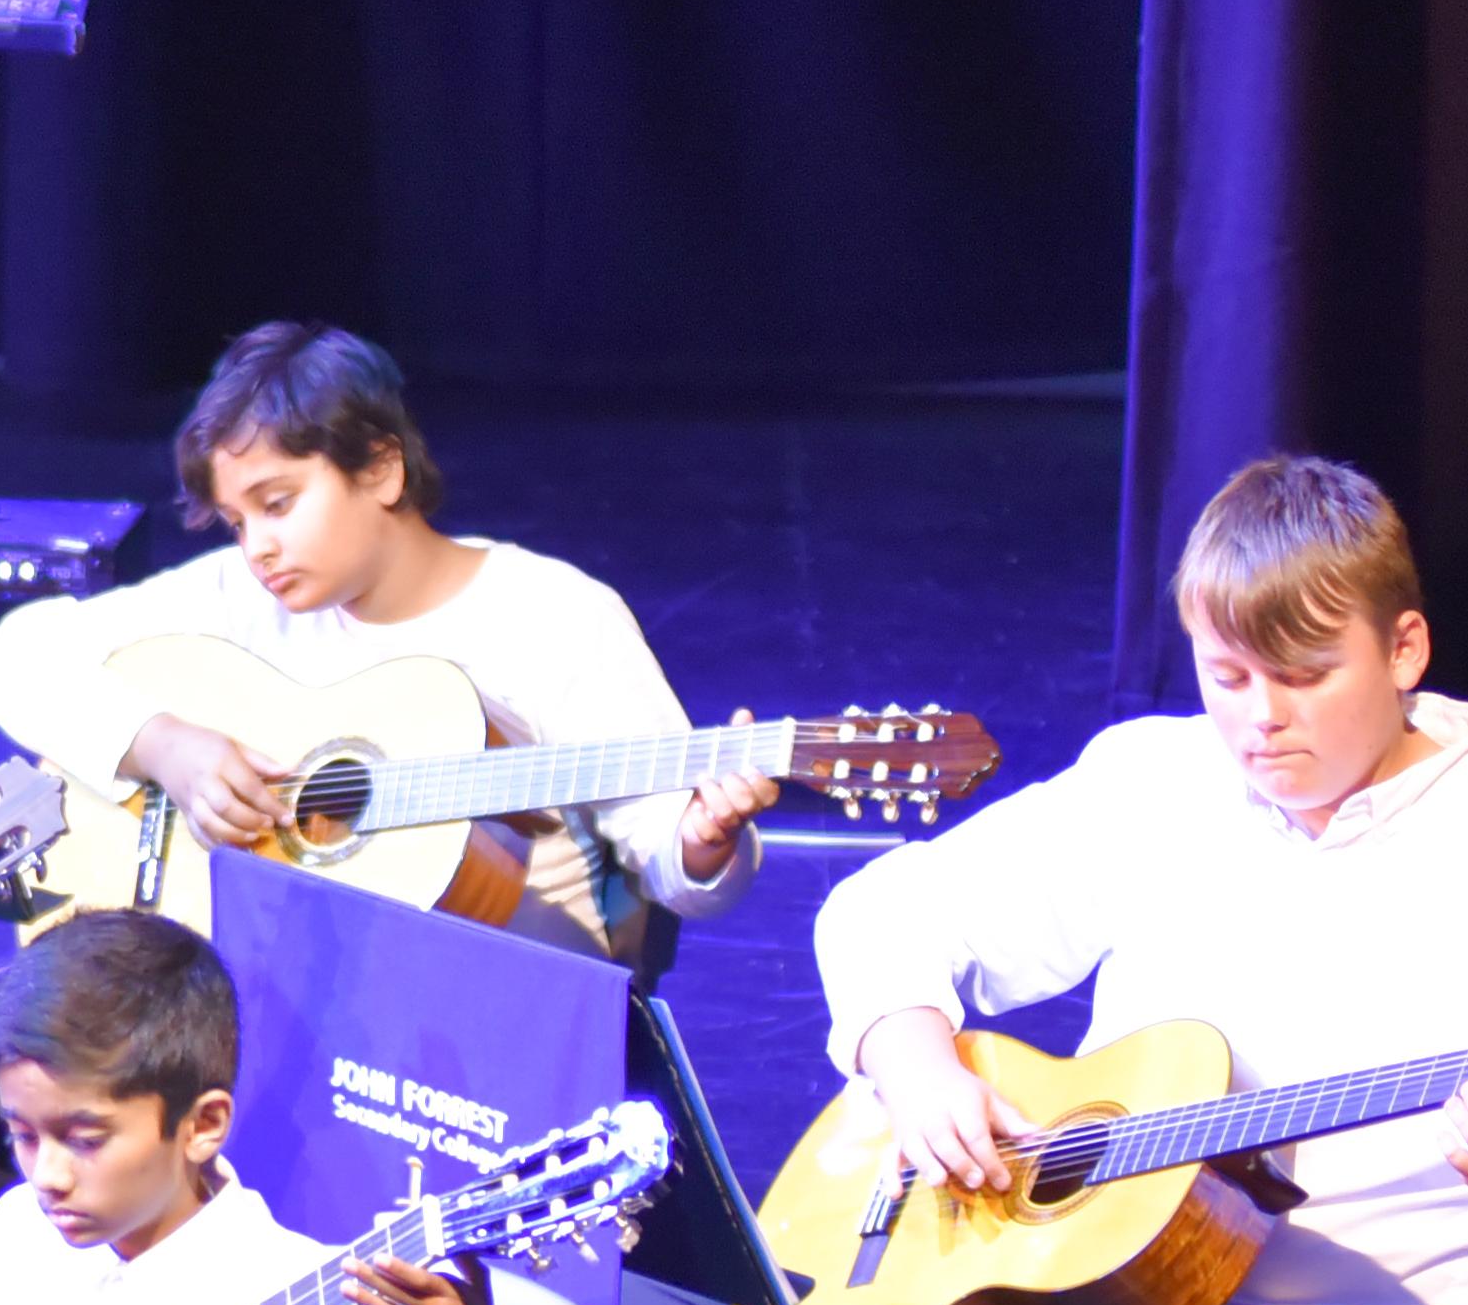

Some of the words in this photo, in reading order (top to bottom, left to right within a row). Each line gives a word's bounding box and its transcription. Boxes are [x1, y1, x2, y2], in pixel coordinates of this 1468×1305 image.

[330, 1057, 396, 1106] JOHN
[402, 1079, 509, 1144] FORREST
[332, 1093, 431, 1152] Secondary
